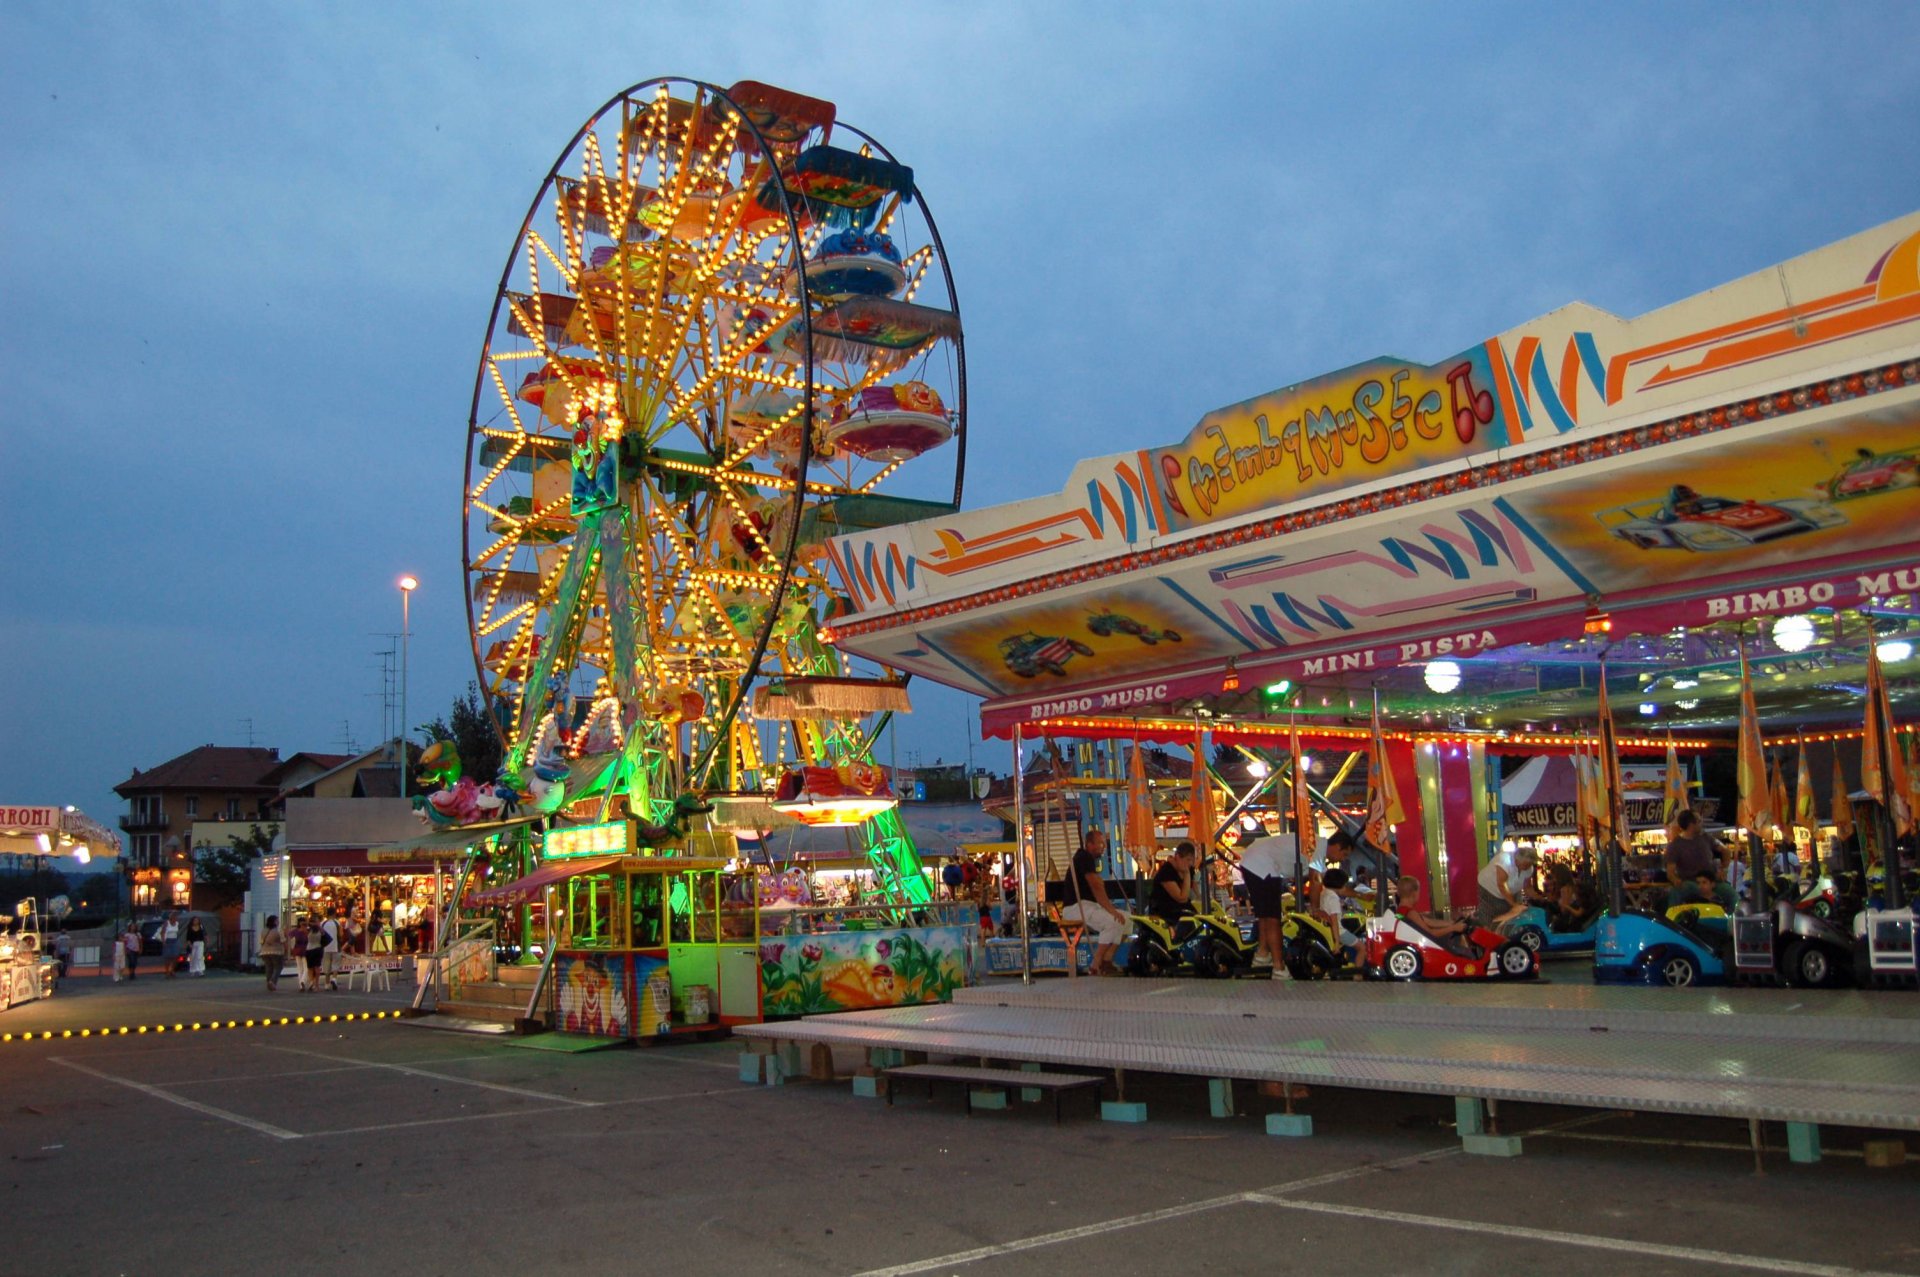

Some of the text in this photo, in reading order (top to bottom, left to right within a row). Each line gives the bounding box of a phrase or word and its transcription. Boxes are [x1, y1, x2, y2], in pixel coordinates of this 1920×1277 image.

[1705, 582, 1835, 619] BIMBO
[1302, 630, 1498, 677] MINI PISTA
[1031, 684, 1167, 719] BIMBO MUSIC
[1516, 806, 1550, 824] NEW
[333, 865, 352, 874] Club
[476, 887, 528, 905] CASSA
